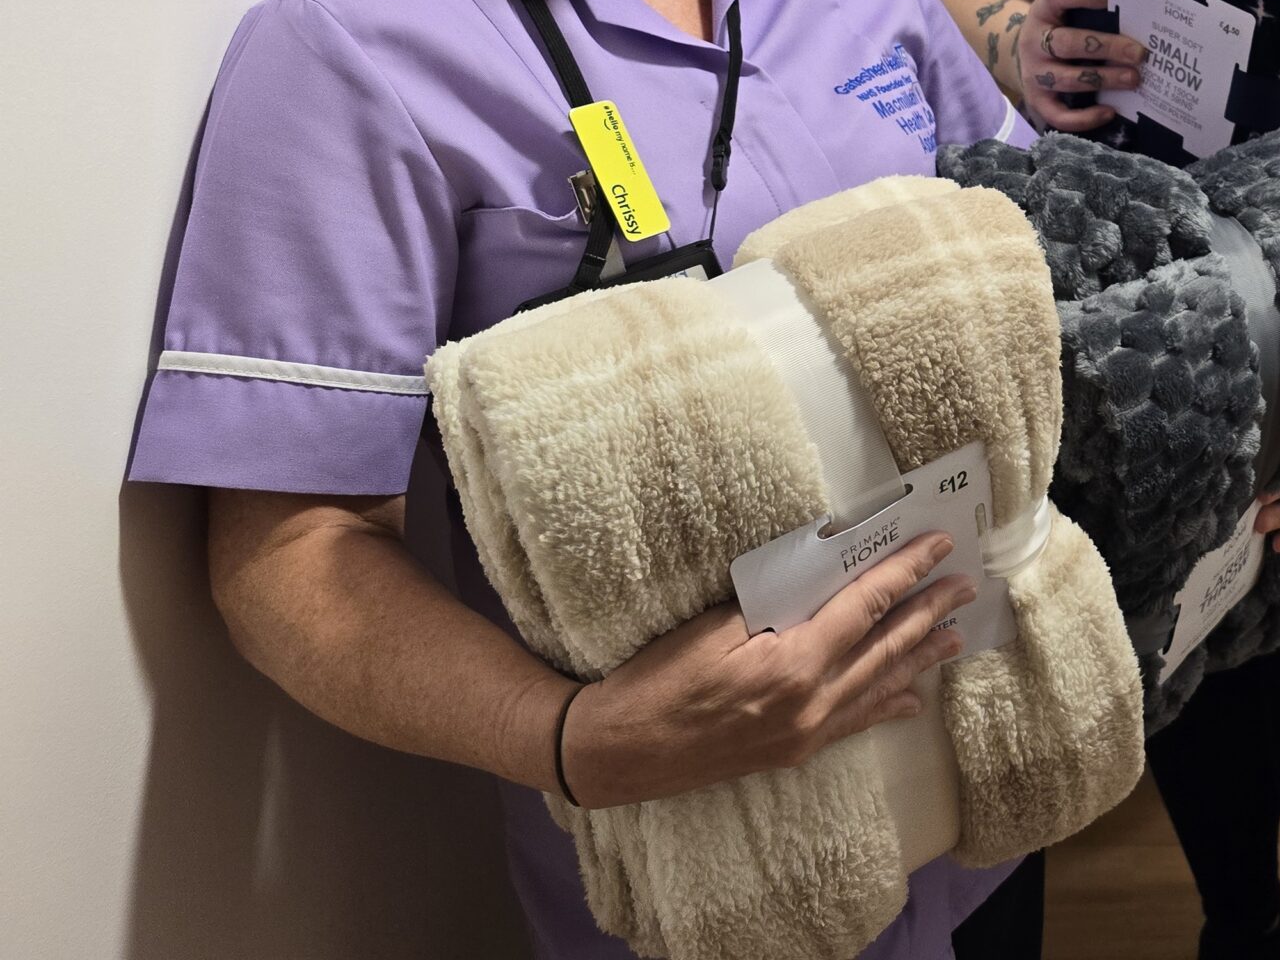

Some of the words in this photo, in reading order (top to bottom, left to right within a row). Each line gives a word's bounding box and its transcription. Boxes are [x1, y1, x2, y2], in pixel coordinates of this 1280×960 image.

[1164, 6, 1193, 28] HOME
[1148, 34, 1201, 75] SMALL
[1152, 21, 1181, 40] SUPER
[1182, 36, 1204, 53] SOFT
[834, 58, 887, 95] Gateshead
[1144, 47, 1203, 91] THROW
[614, 131, 624, 142] my
[620, 142, 633, 162] name
[612, 184, 642, 235] Chrissy
[938, 470, 969, 495] £12
[840, 518, 898, 559] PRIMARK
[843, 526, 901, 573] HOME
